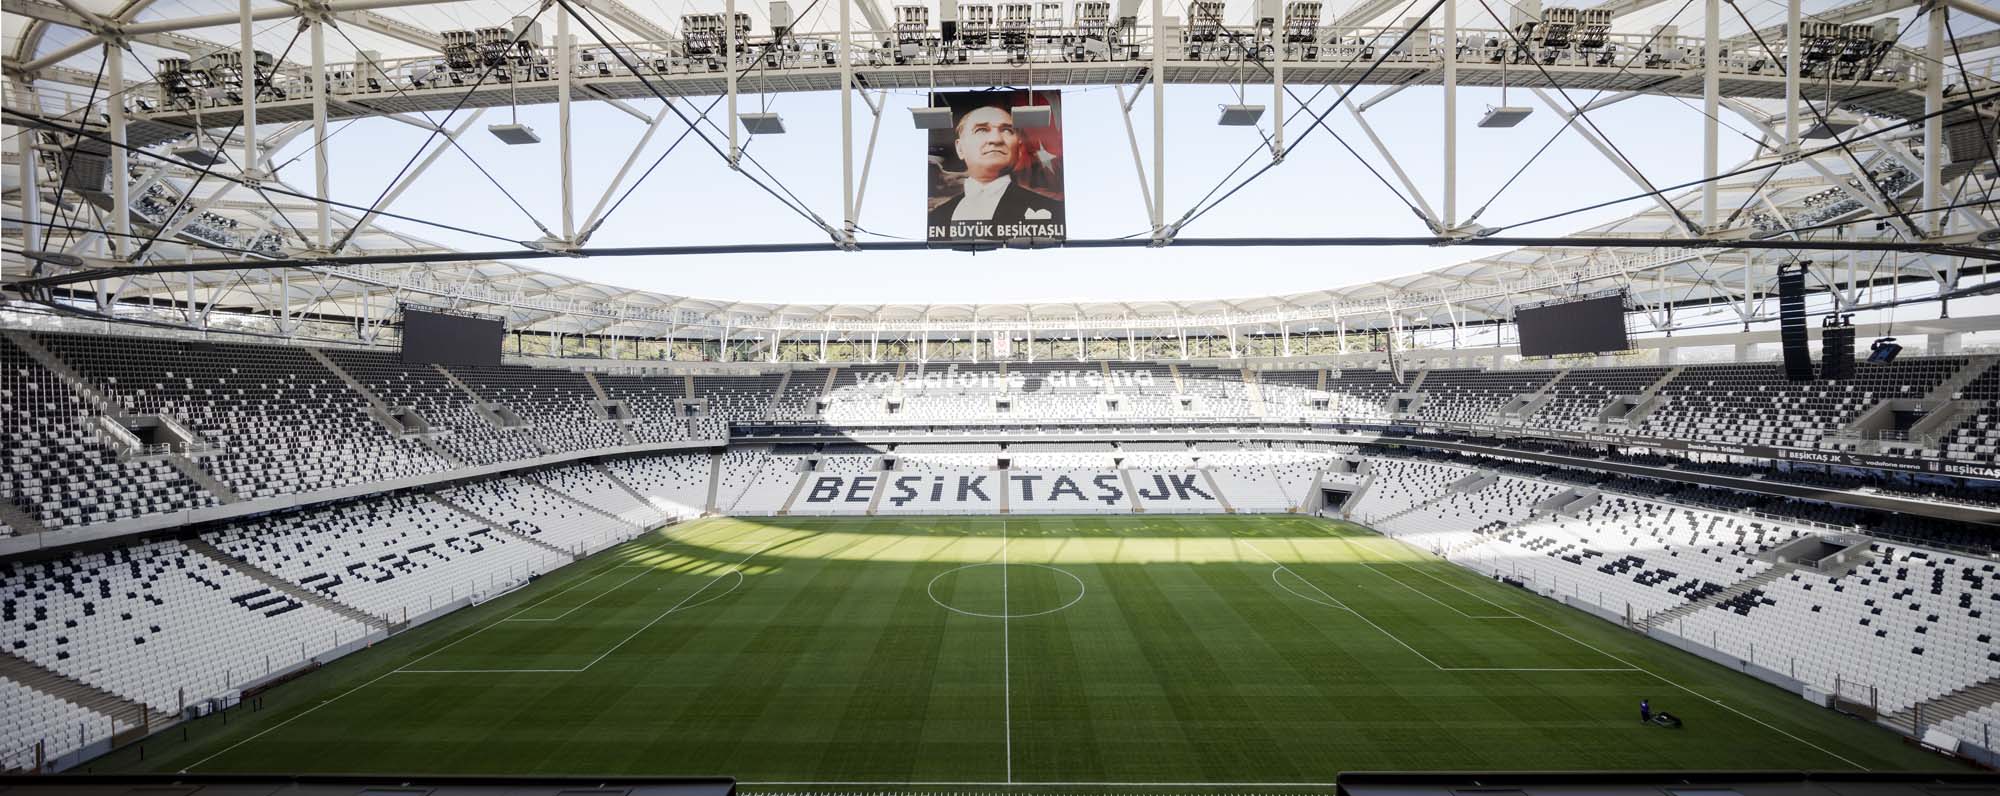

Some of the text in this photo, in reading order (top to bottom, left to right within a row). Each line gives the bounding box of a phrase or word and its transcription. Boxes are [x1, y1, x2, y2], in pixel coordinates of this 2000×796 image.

[928, 221, 1064, 239] EN BÜYÜK BEŞİKTAŞLI
[855, 363, 1155, 389] vodafone arena
[1789, 451, 1841, 463] BEŞİKTAŞ JK
[1865, 460, 1898, 468] vodafone
[1139, 474, 1215, 501] JK
